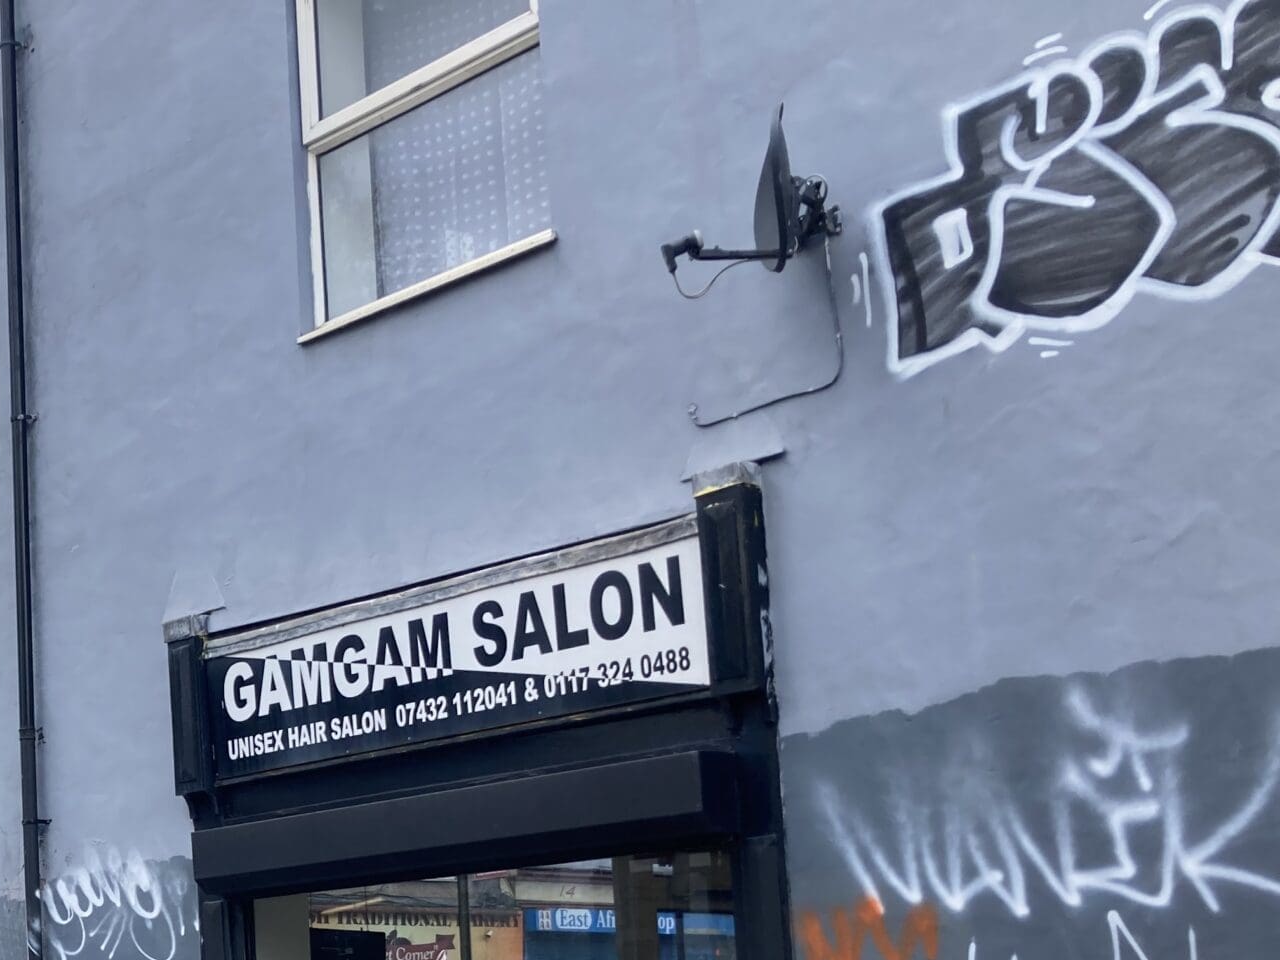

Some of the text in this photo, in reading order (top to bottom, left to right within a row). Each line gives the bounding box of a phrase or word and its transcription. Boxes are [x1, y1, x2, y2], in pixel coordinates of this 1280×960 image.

[223, 554, 686, 722] GAMGAM SALON
[227, 646, 691, 760] UNISEX HAIR SALON 07432 112041 & 0117 324 0488
[560, 910, 589, 927] East
